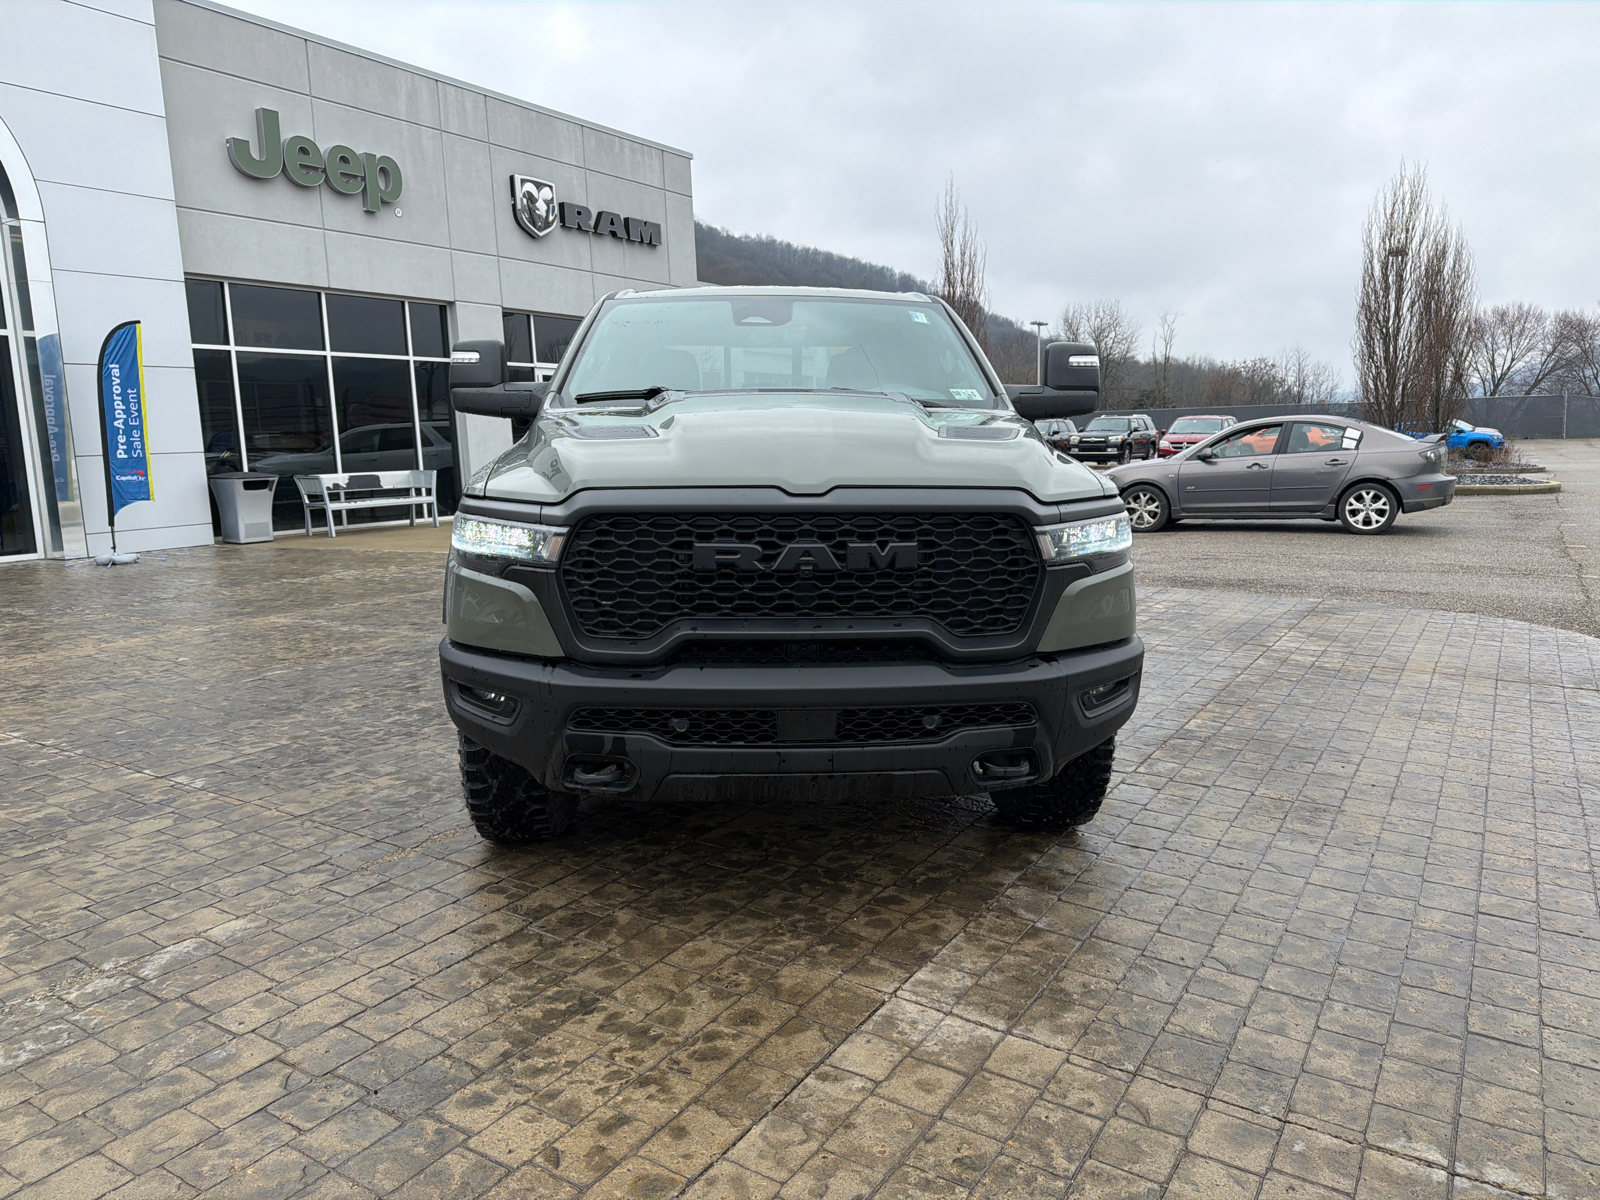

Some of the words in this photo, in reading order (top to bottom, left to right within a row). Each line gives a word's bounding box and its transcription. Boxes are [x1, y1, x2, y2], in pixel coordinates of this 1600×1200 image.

[226, 107, 402, 213] Jeep
[558, 201, 661, 247] RAM
[109, 364, 128, 459] Pre-Approval
[127, 388, 140, 426] Event
[130, 429, 143, 458] Sale
[693, 542, 918, 571] RAM
